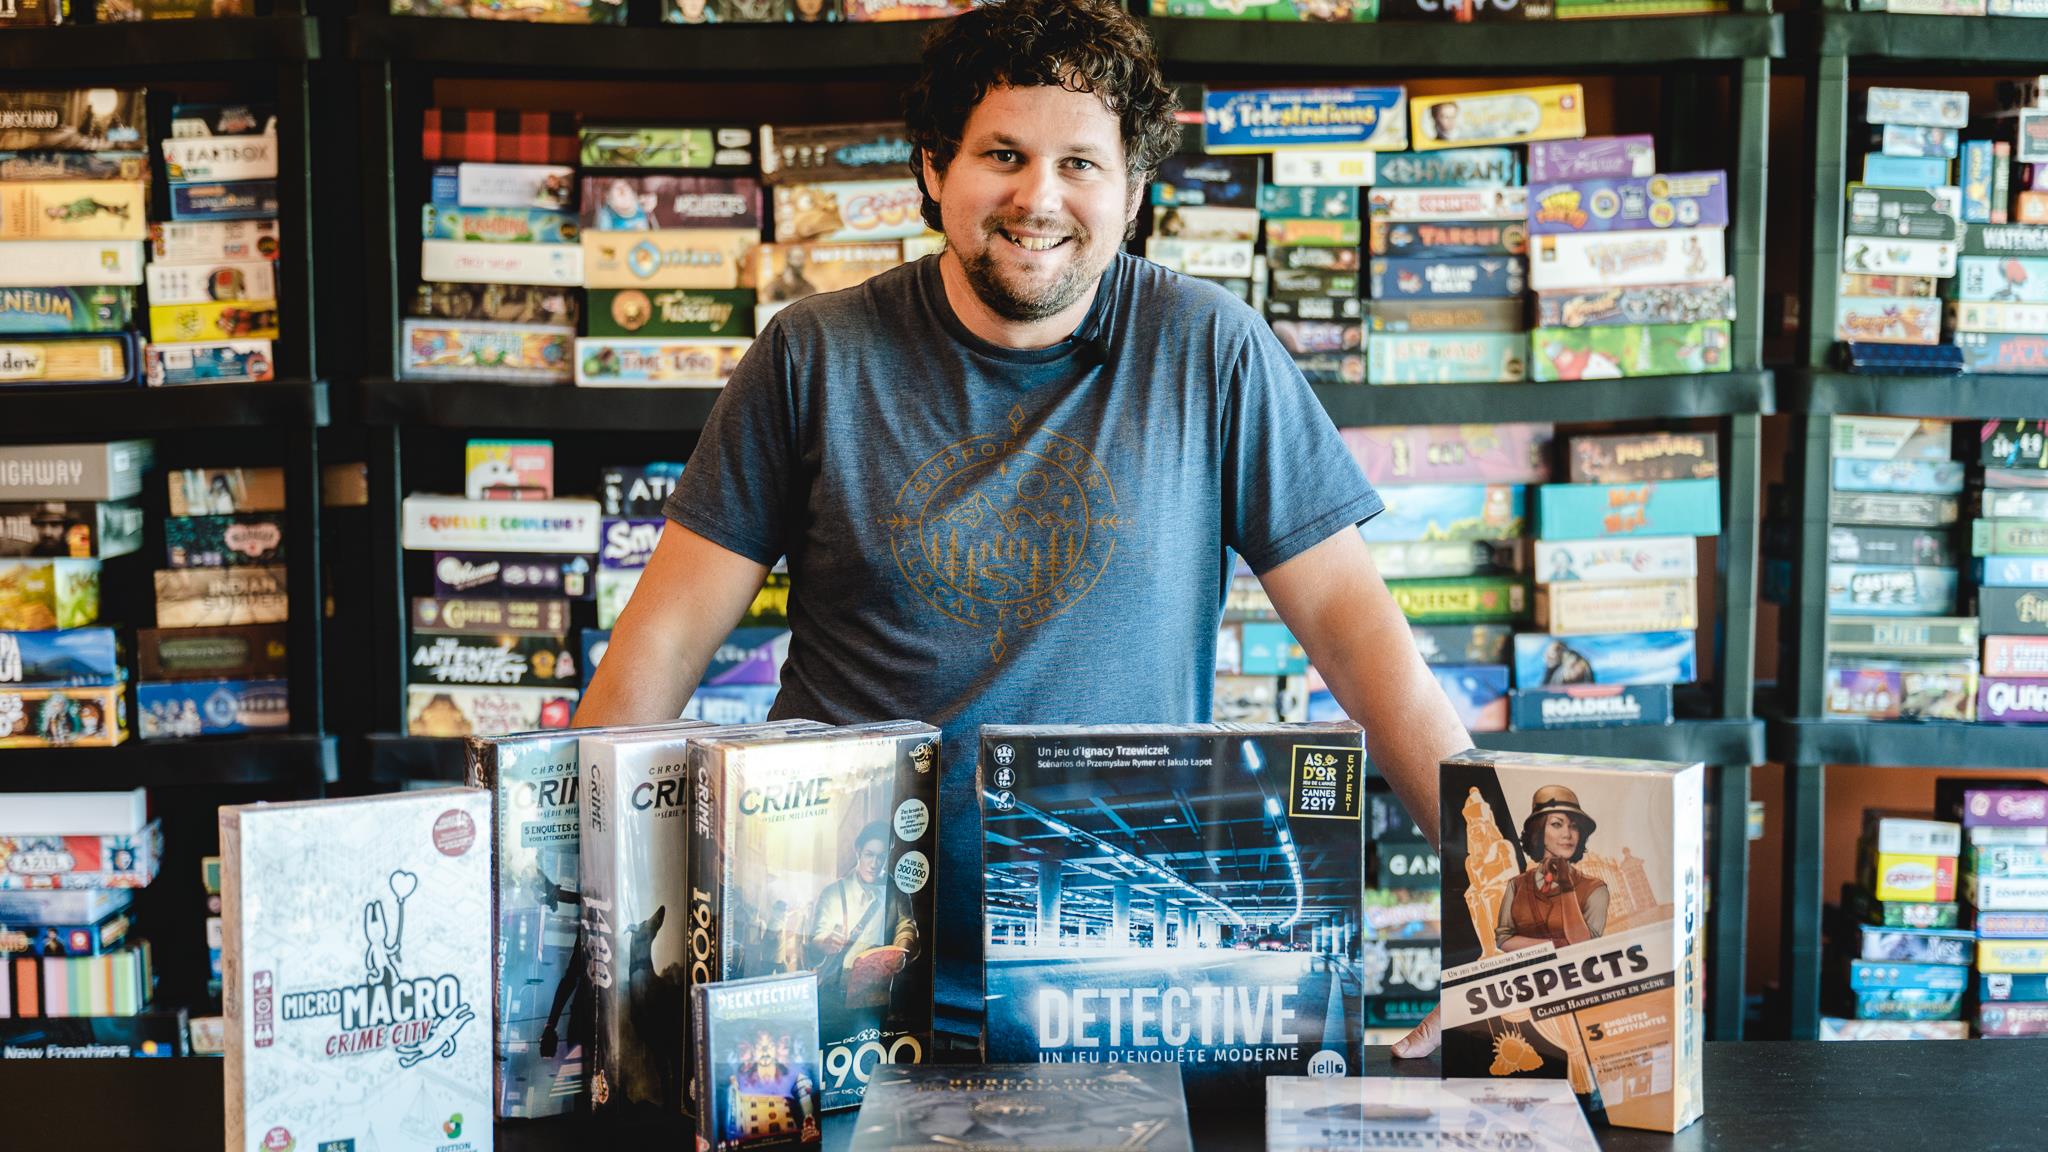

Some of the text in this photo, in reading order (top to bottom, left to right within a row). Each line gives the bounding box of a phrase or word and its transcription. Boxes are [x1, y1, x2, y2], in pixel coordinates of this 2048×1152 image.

[1239, 103, 1376, 128] Telestrations
[1419, 225, 1500, 246] TARGUI
[1044, 440, 1101, 489] YOUR
[429, 515, 489, 531] QUELLE
[604, 521, 663, 560] Sm
[905, 557, 1097, 621] LOCAL FOREST
[430, 662, 528, 684] PROJECT
[1542, 696, 1641, 718] ROADKILL
[1038, 744, 1170, 759] Un jeu d'Ignacy Trzewiczek
[1038, 758, 1075, 769] Scénarios
[1076, 759, 1086, 768] de
[1132, 758, 1157, 769] Rymer
[1158, 760, 1167, 768] et
[1168, 757, 1189, 768] Jakub
[1304, 752, 1323, 767] AS
[1303, 766, 1337, 781] D'OR
[1344, 754, 1355, 812] EXPERT
[591, 763, 603, 833] CRIME
[697, 767, 711, 840] CRIME
[738, 777, 833, 816] CRIME
[1300, 796, 1337, 811] 2019
[1301, 788, 1337, 798] CANNES
[525, 826, 530, 834] 5
[531, 821, 571, 834] ENQUÊTES
[912, 865, 927, 879] 000
[582, 894, 613, 990] 1400
[1465, 944, 1649, 1016] SUSPECTS
[717, 983, 810, 1012] DECKTECTIVE
[1038, 984, 1300, 1049] DETECTIVE
[1586, 1011, 1649, 1042] 3 ENQUÊTES
[1606, 1015, 1668, 1038] CAPTIVANTES
[325, 1019, 433, 1056] CRIME CITY
[1038, 1049, 1065, 1064] UN
[1108, 1046, 1207, 1064] D'ENQUÊTE
[1214, 1046, 1300, 1063] MODERNE
